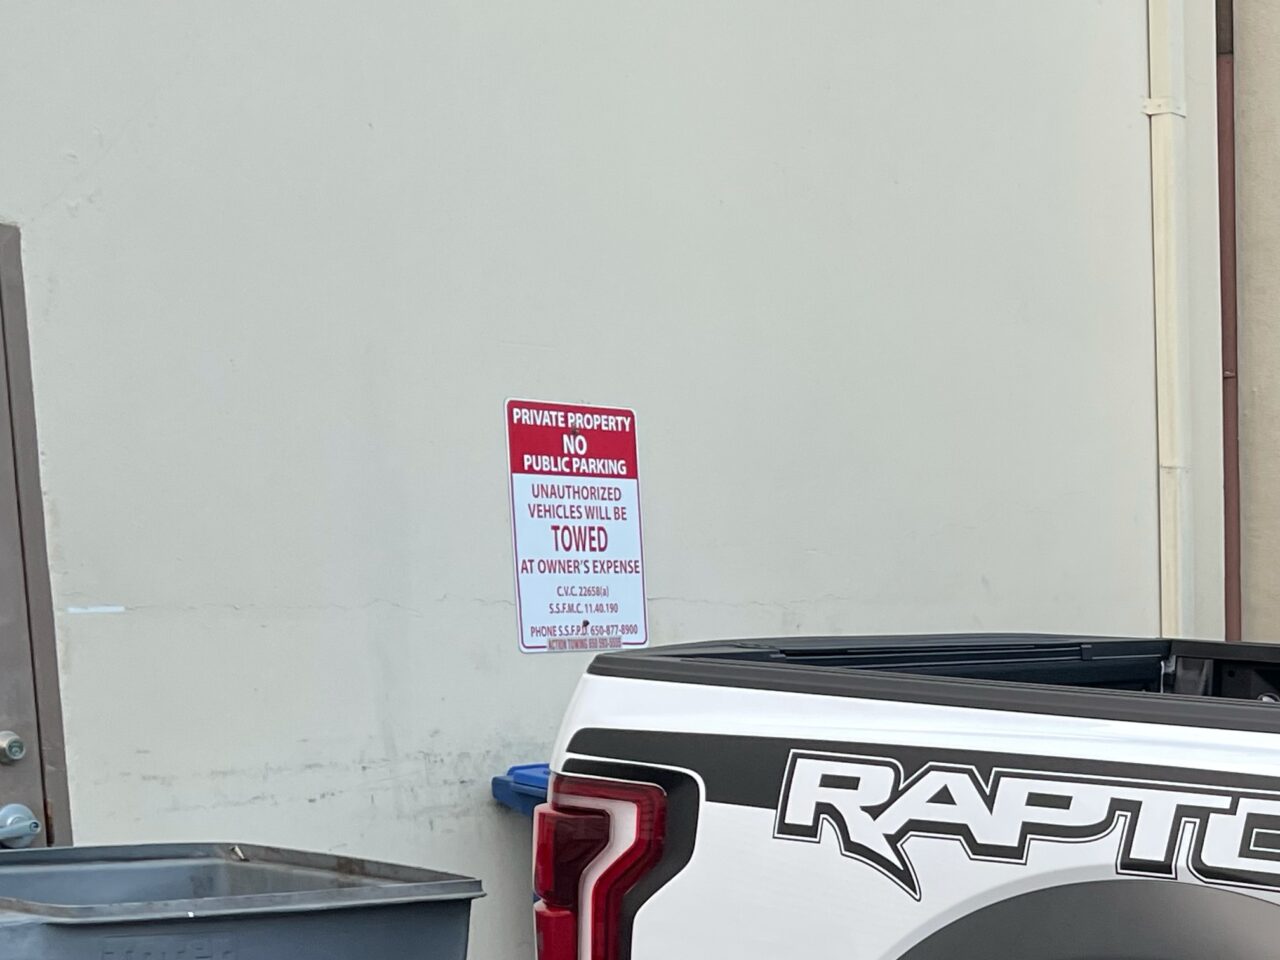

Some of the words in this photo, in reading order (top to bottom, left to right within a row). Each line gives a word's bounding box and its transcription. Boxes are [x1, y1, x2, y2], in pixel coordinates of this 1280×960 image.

[513, 408, 565, 427] PRIVATE
[567, 412, 631, 432] PROPERTY
[562, 434, 587, 455] NO
[523, 454, 570, 473] PUBLIC
[572, 457, 627, 475] PARKING
[531, 483, 622, 502] UNAUTHORIZED
[527, 503, 583, 520] VEHICLES
[584, 505, 612, 521] WILL
[613, 506, 628, 521] BE
[550, 525, 608, 553] TOWED
[520, 559, 535, 574] AT
[537, 559, 590, 574] OWNER'S
[592, 559, 641, 574] EXPENSE
[556, 586, 578, 597] C.V.C.
[549, 603, 583, 614] S.S.F.M.C.
[585, 603, 619, 614] 11.40.190
[530, 625, 557, 637] PHONE
[590, 624, 639, 635] 650-877-8900
